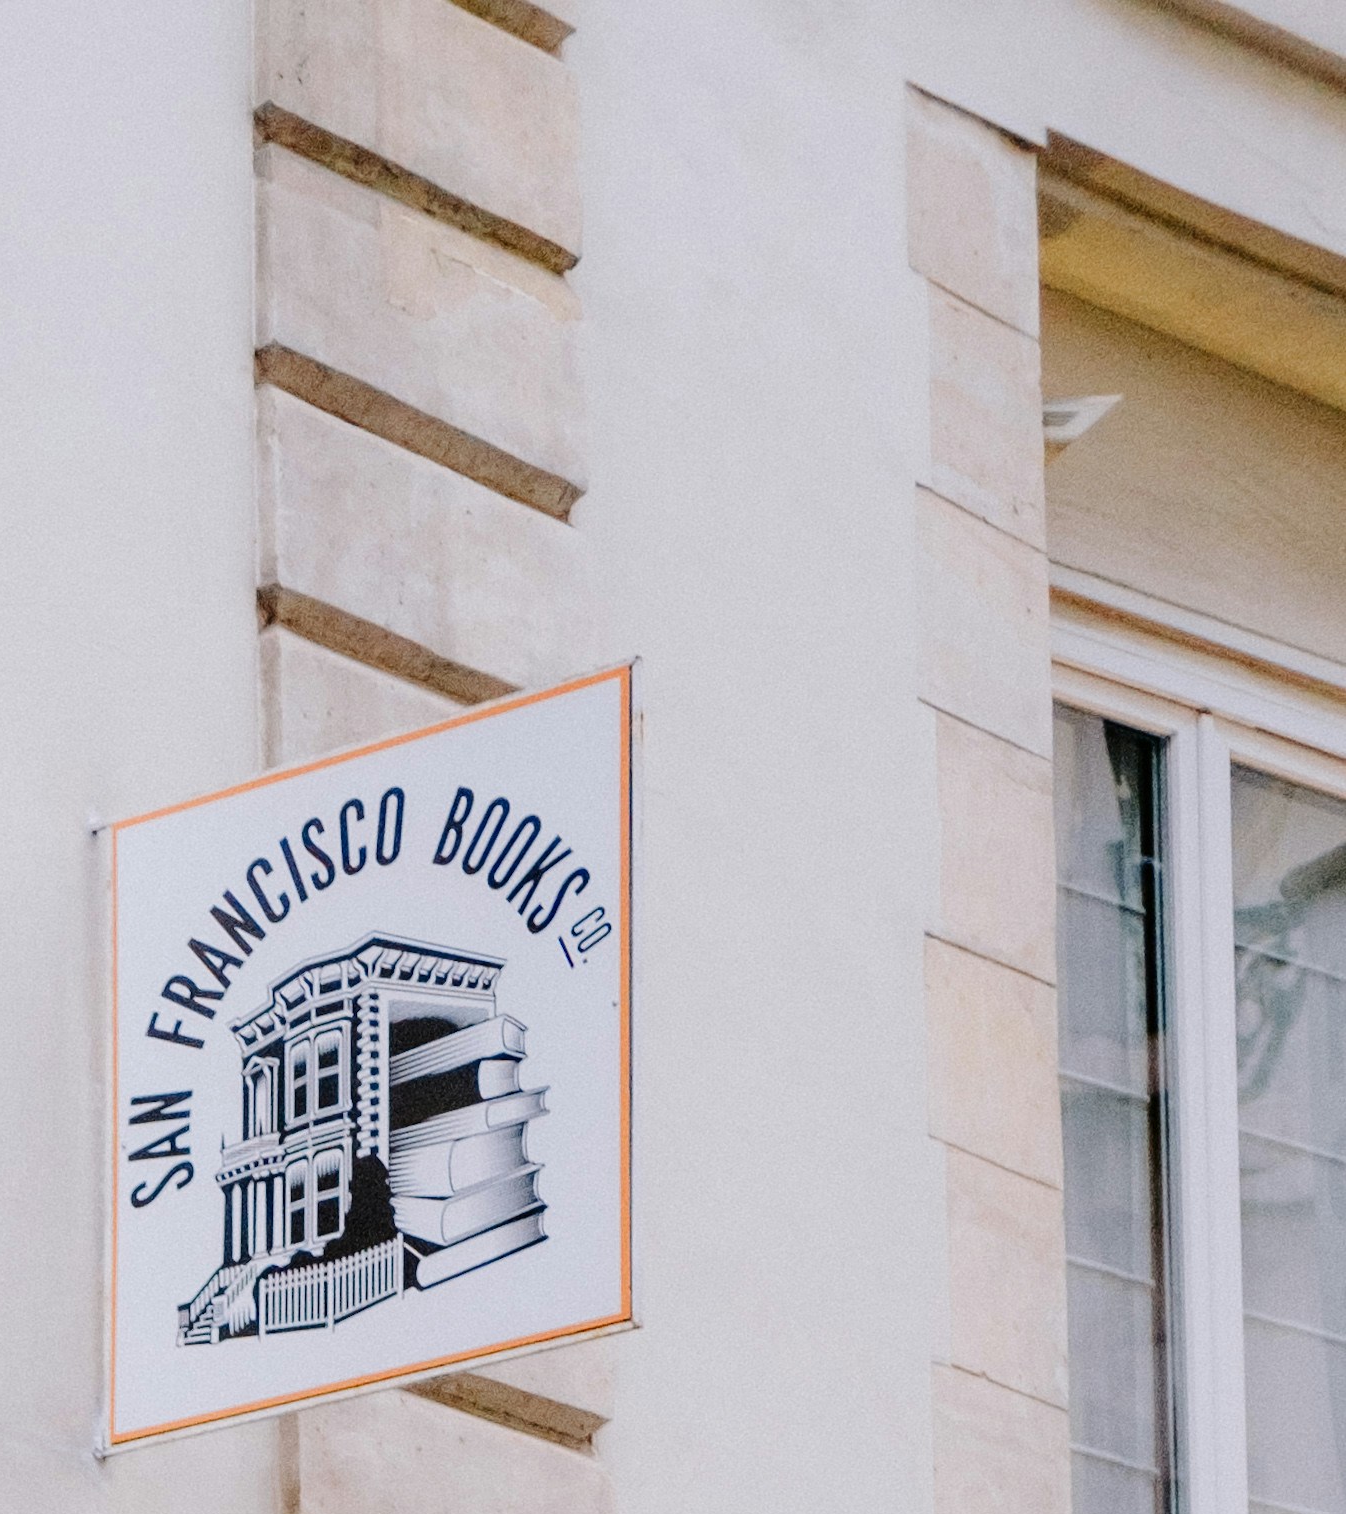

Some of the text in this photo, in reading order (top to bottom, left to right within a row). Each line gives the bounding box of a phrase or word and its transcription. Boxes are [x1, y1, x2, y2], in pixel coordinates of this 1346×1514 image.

[146, 785, 406, 1050] FRANCISCO
[433, 785, 592, 936] BOOKS
[130, 1089, 195, 1210] SAN
